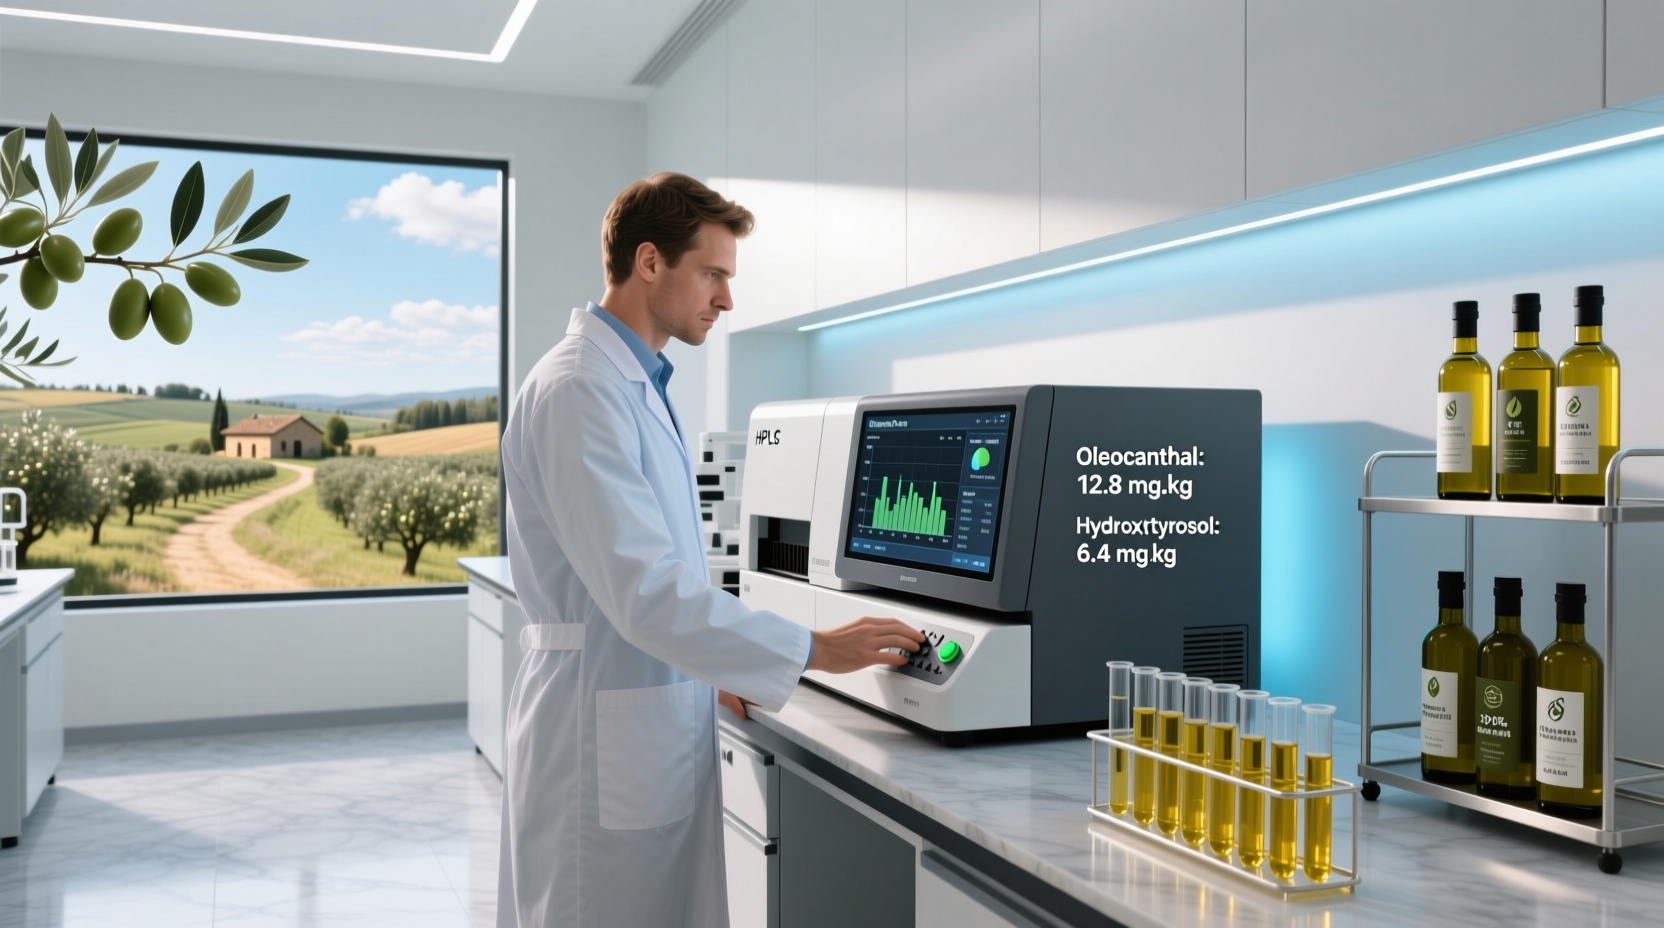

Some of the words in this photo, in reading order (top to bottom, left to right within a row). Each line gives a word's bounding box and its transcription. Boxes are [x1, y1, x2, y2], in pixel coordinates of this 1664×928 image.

[1076, 446, 1204, 466] Oleocanthal:
[1077, 474, 1122, 495] 12.8
[1128, 473, 1193, 500] mg.kg
[1076, 543, 1111, 563] 6.4
